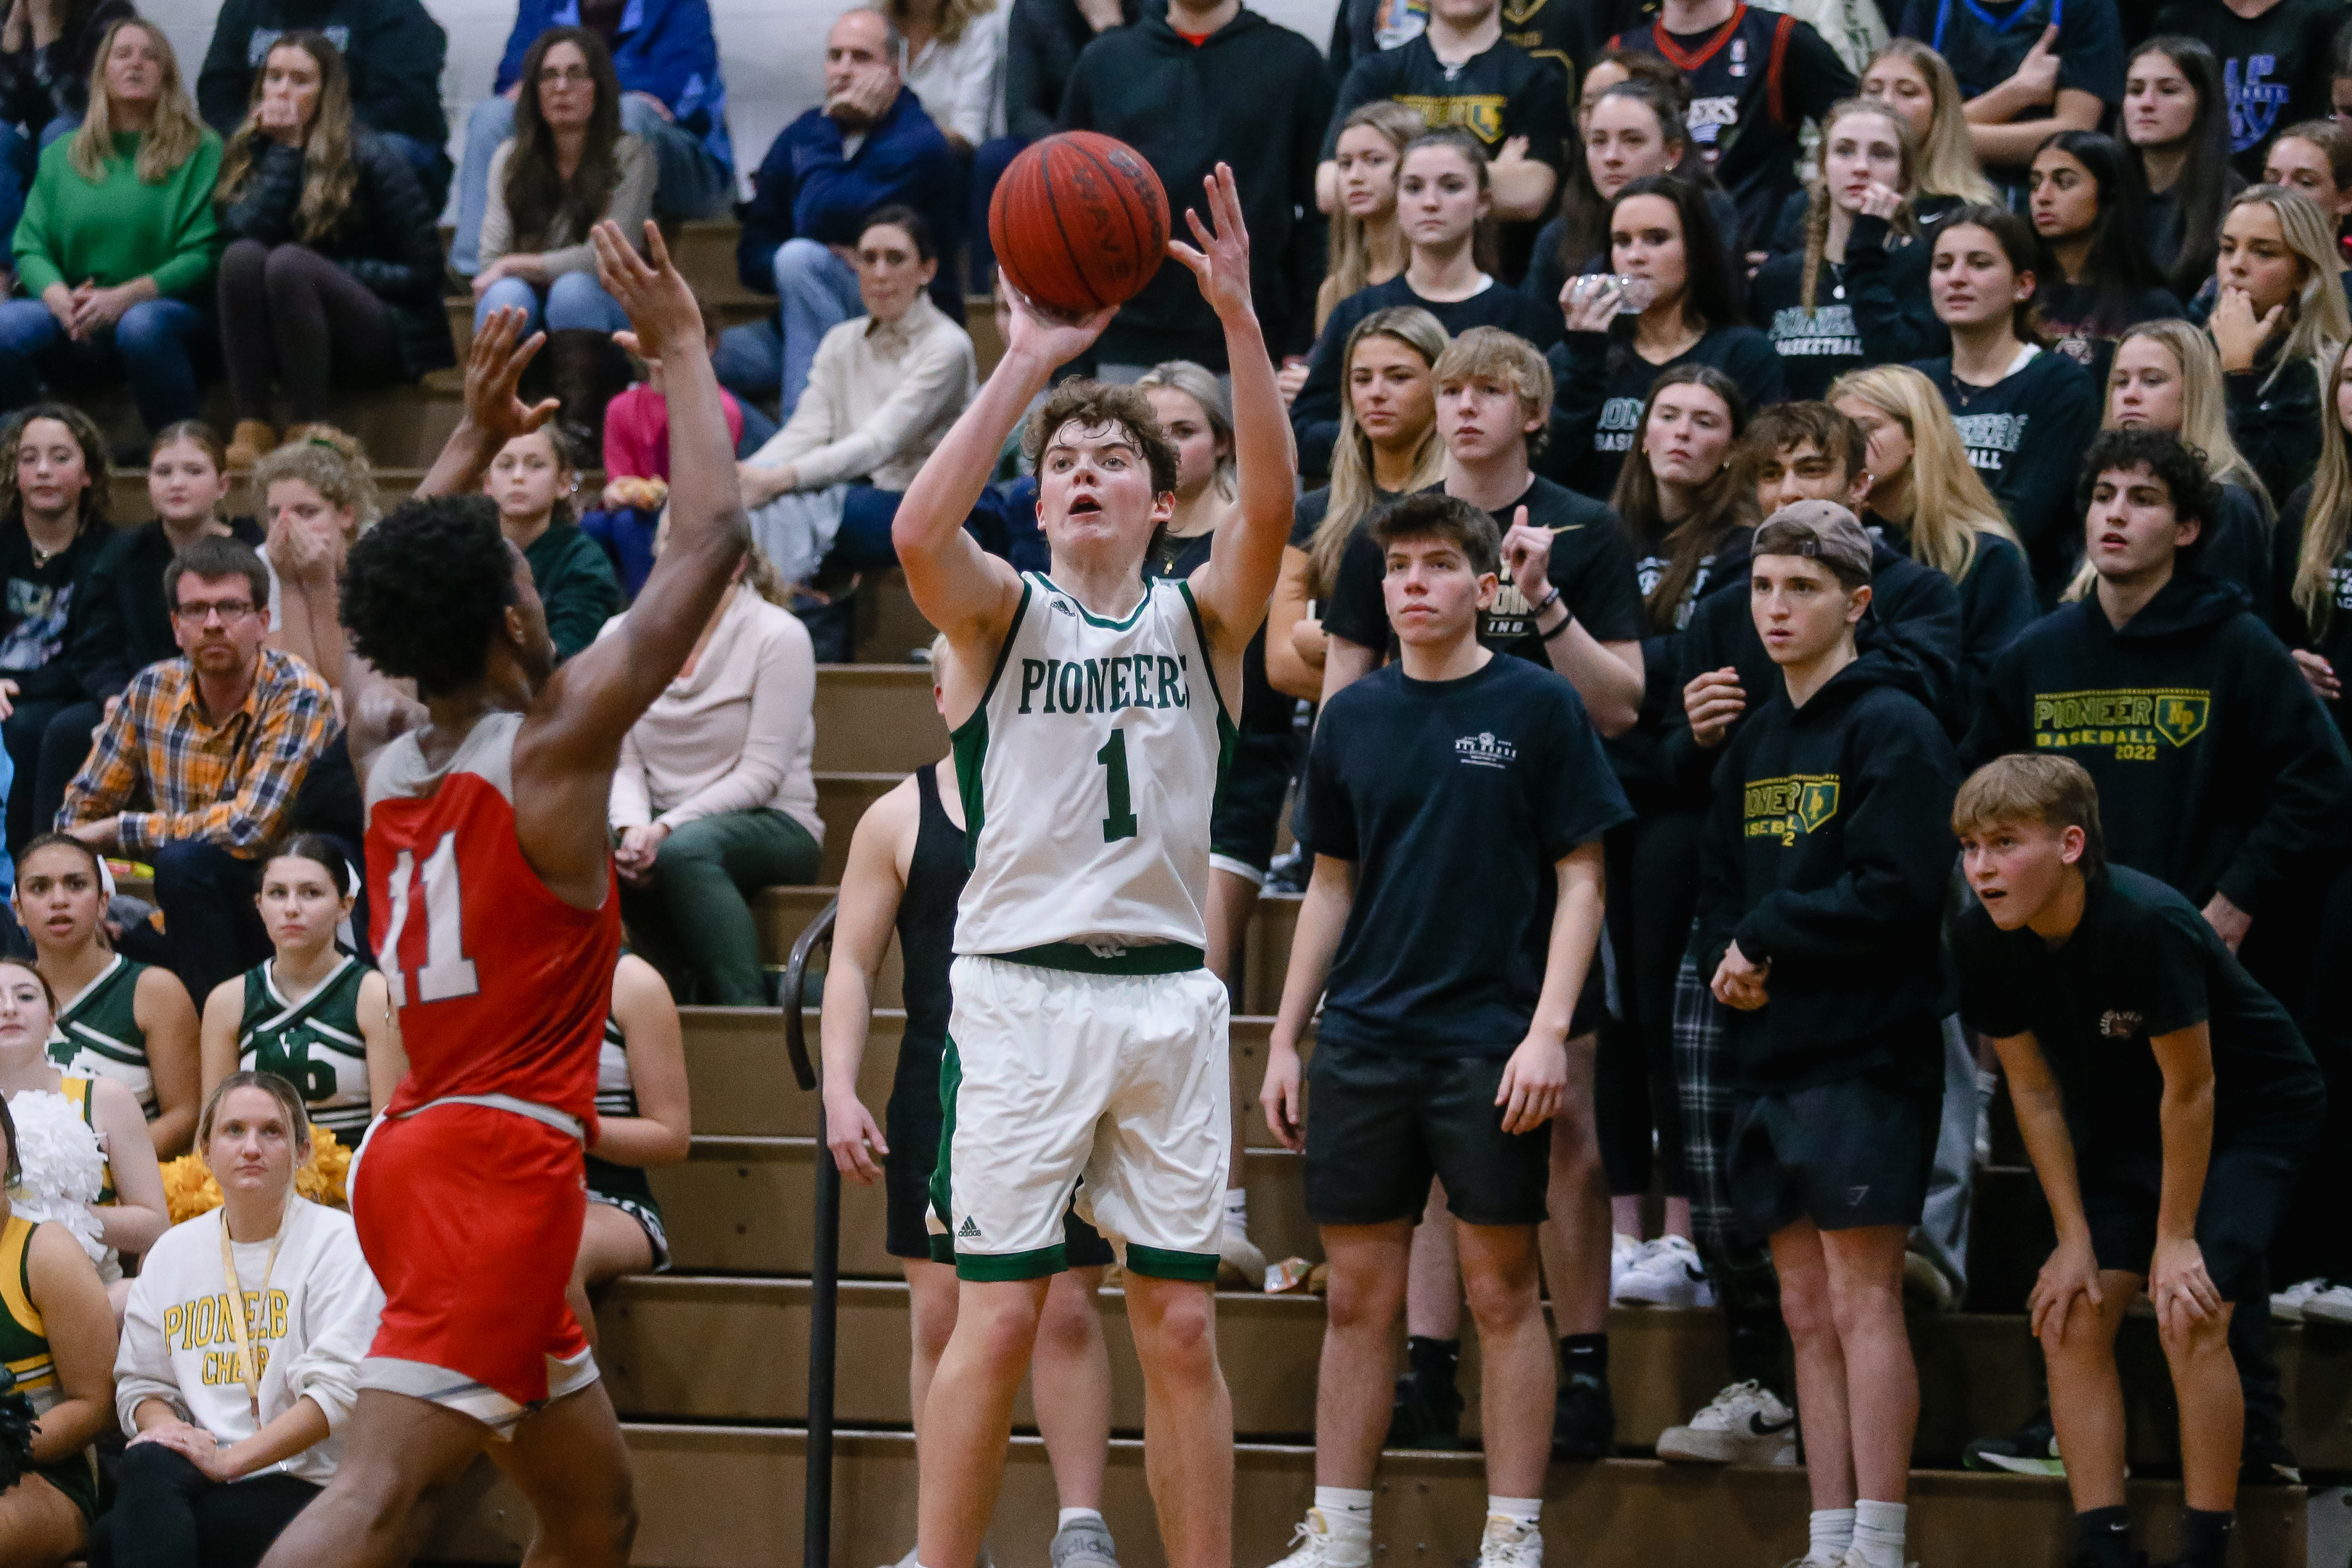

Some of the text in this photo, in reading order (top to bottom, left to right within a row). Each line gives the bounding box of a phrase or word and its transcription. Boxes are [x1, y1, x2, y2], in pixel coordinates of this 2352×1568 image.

[1686, 96, 1739, 129] ERS
[1488, 621, 1524, 632] ING
[2034, 696, 2153, 730] PIONEER
[2035, 729, 2157, 747] BASEBALL
[2115, 745, 2157, 760] 2022
[1097, 728, 1138, 844] 1
[375, 828, 481, 1008] 11
[202, 1345, 270, 1386] CHER
